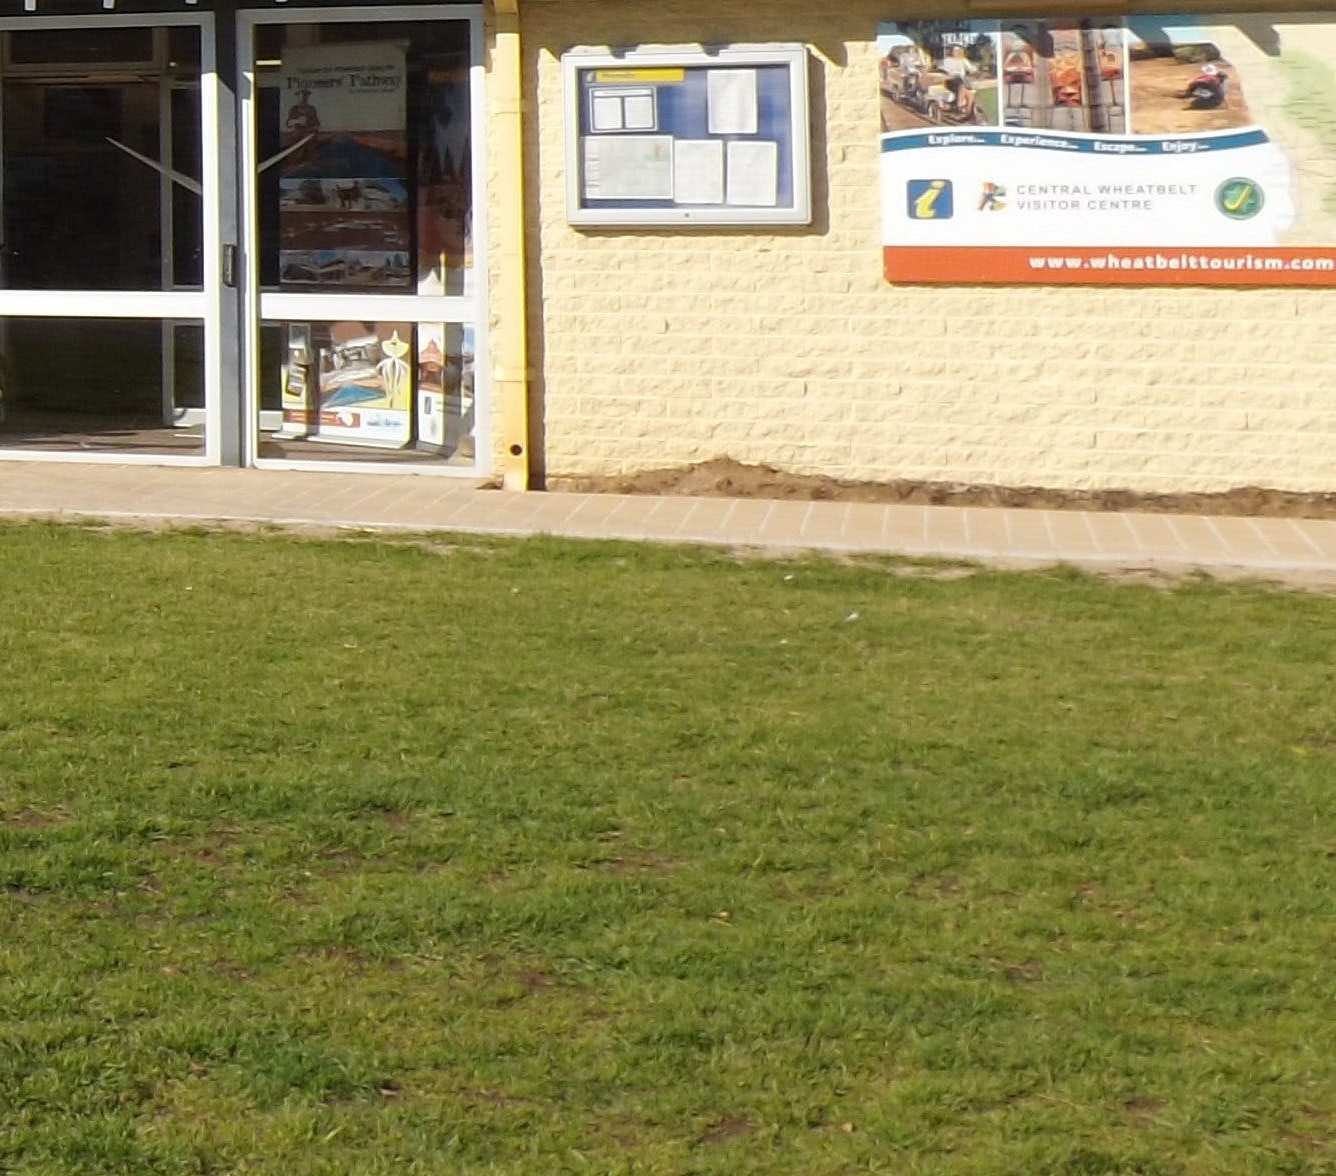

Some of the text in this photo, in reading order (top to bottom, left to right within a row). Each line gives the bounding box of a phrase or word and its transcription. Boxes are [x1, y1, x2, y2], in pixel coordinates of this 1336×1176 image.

[1016, 184, 1198, 195] CENTRAL WHEATBELT
[1016, 200, 1153, 210] VISITOR CENTRE
[1029, 253, 1333, 270] www.wheatbelttourism.com
